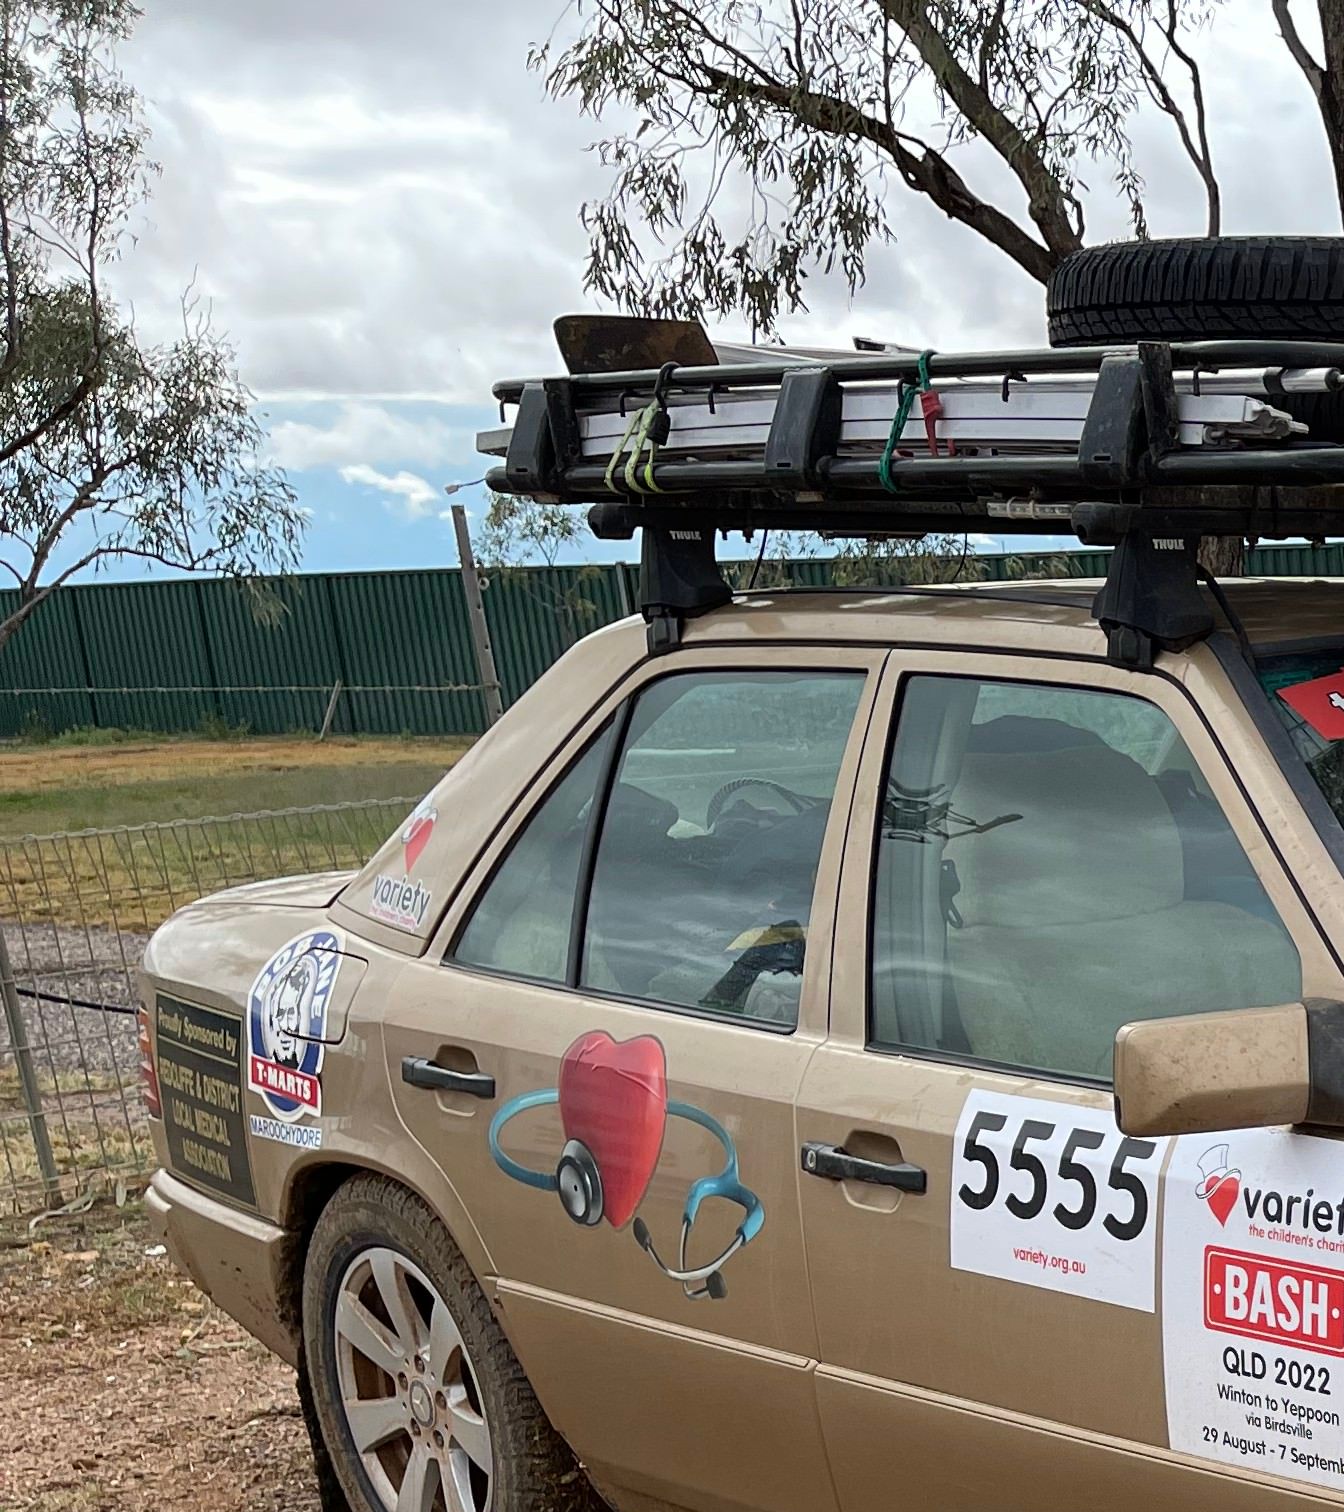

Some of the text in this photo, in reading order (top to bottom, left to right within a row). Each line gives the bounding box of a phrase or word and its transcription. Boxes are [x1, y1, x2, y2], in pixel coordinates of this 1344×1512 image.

[1152, 538, 1184, 550] THULE
[373, 876, 431, 925] variety
[184, 1016, 224, 1050] Sponsored
[226, 1030, 237, 1057] by
[251, 1116, 321, 1148] MAROOCHYDORE
[958, 1110, 1157, 1241] 5555
[1249, 1224, 1265, 1238] the
[1268, 1227, 1314, 1248] children's
[1013, 1247, 1086, 1274] variety.org.au
[1224, 1264, 1329, 1339] BASH
[1223, 1346, 1331, 1395] QLD 2022
[1217, 1383, 1340, 1426] Winton to Yeppoon
[1202, 1425, 1218, 1443] 29
[1222, 1431, 1266, 1455] August
[1278, 1444, 1287, 1460] 7
[1245, 1412, 1313, 1440] via Birdsville
